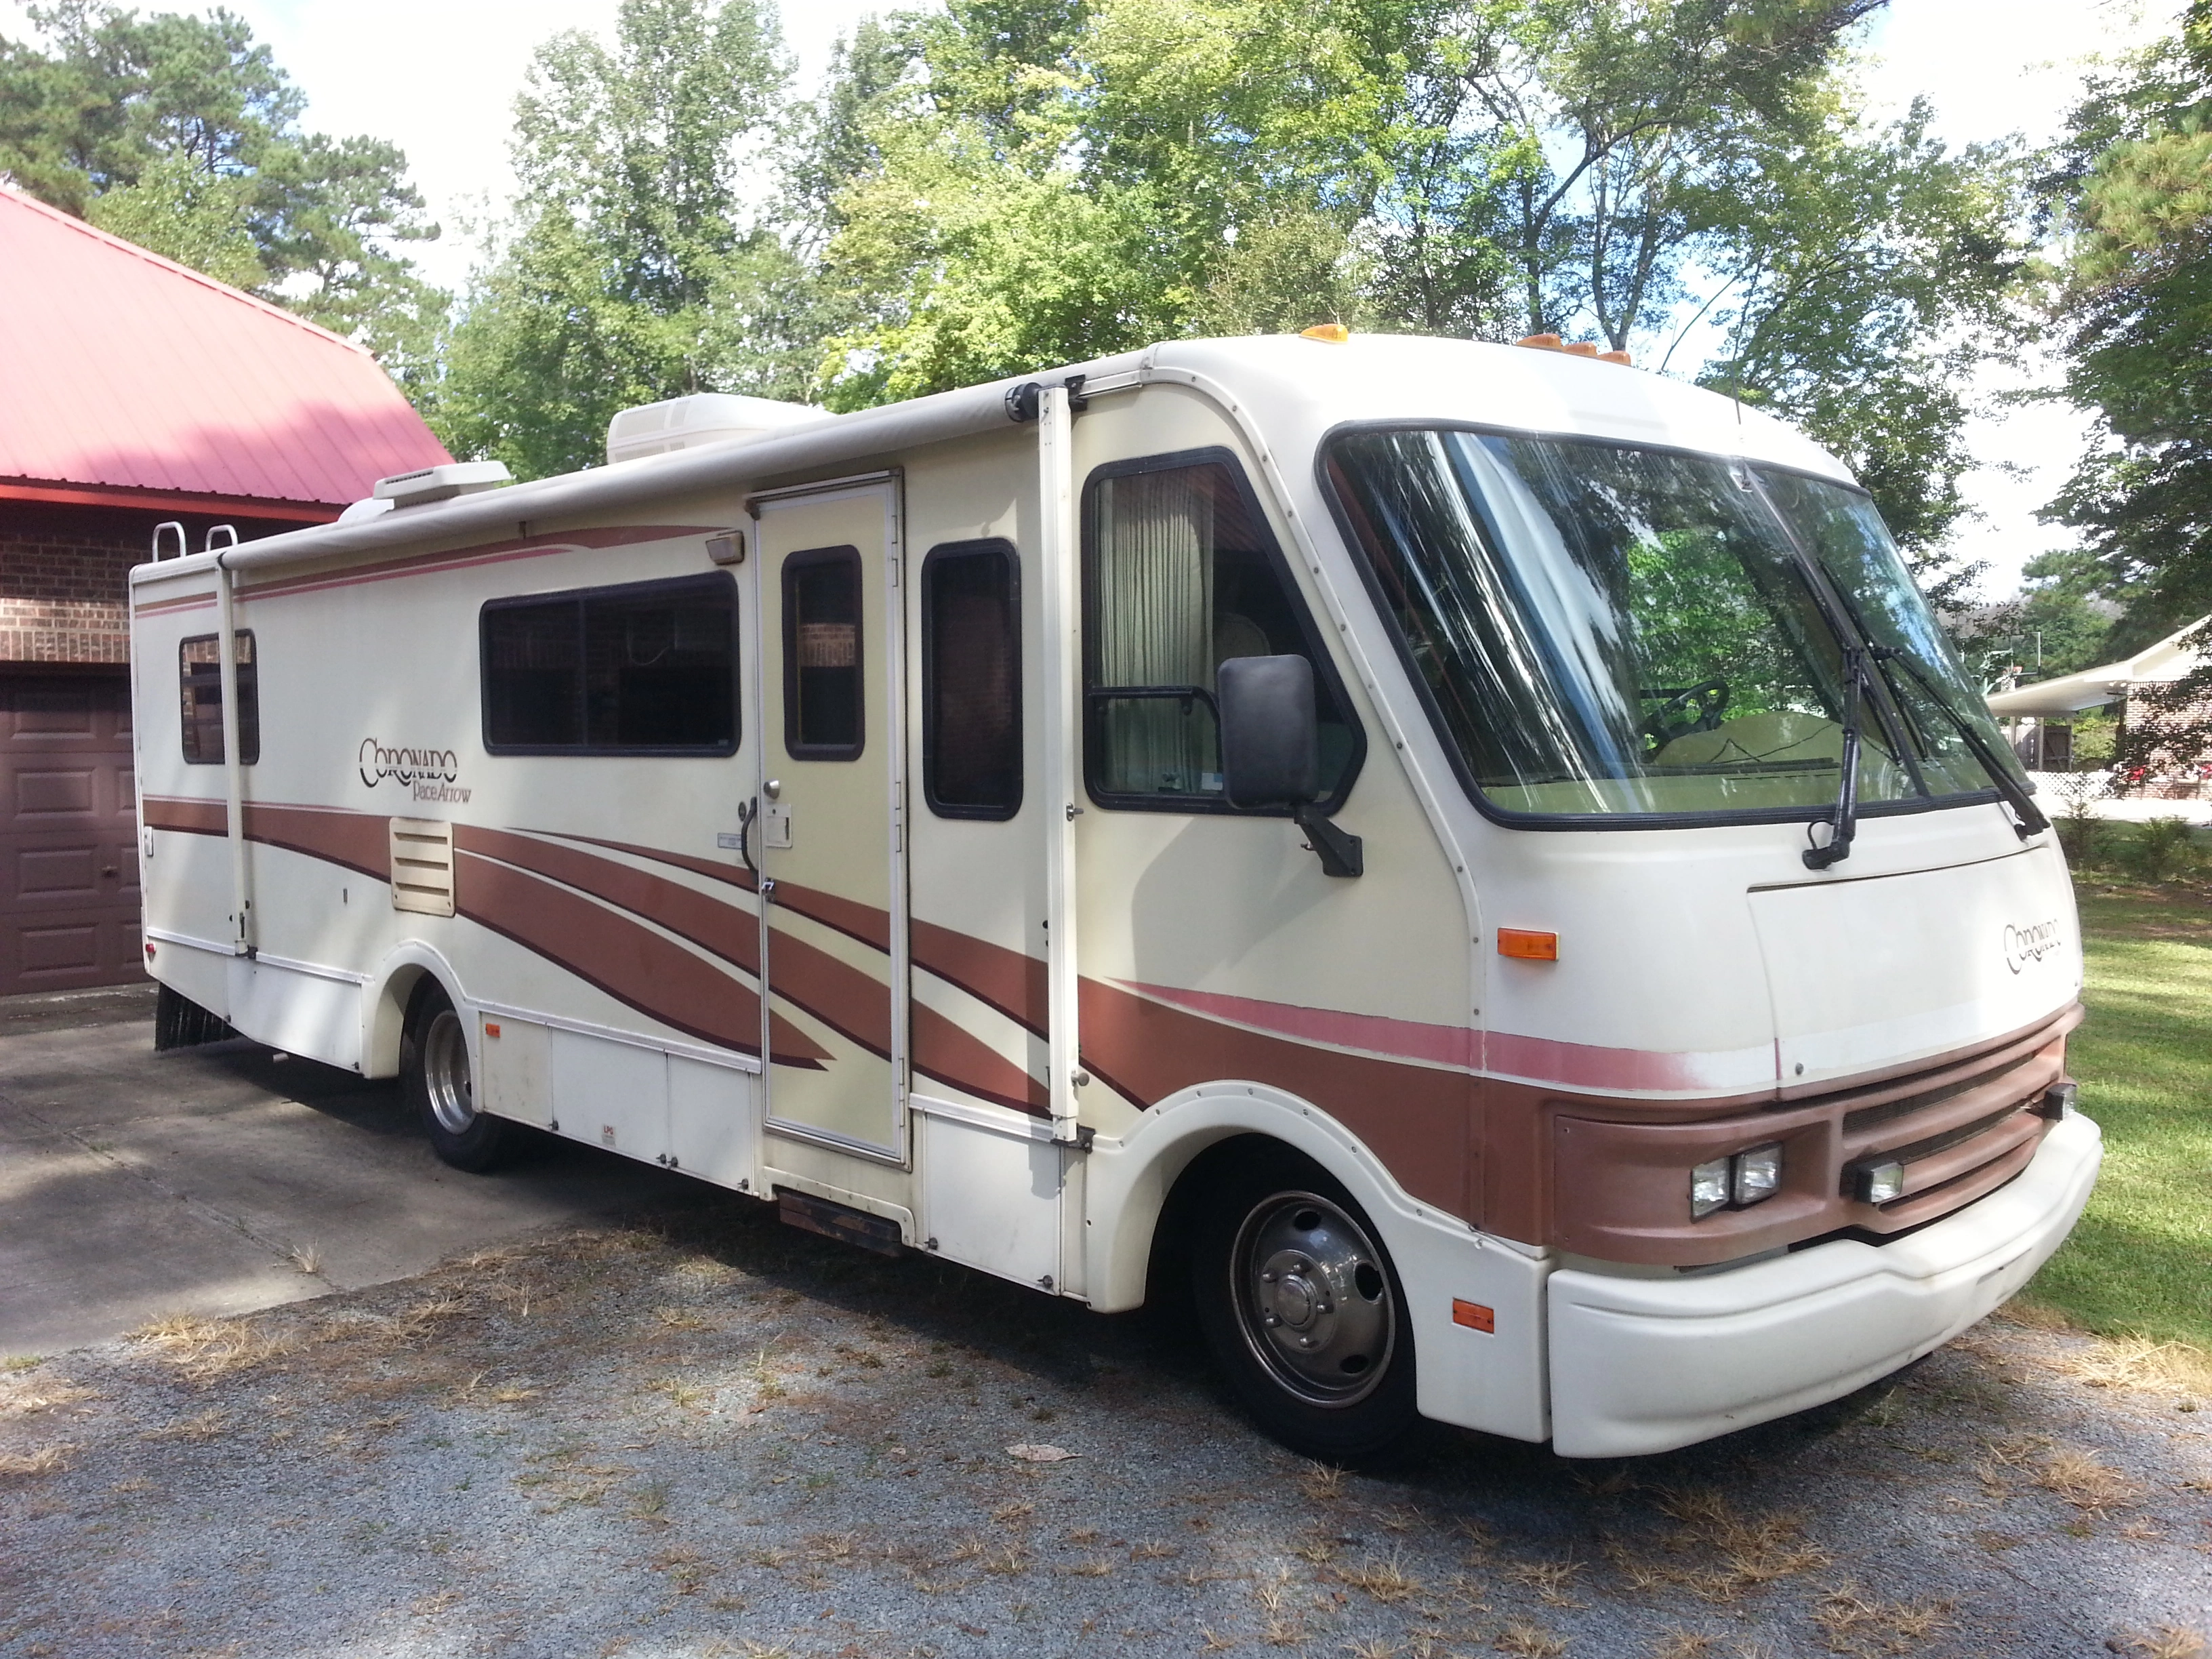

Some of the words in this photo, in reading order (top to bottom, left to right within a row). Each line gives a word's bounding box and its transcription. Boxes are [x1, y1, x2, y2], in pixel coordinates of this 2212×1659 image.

[360, 738, 457, 788] CORONADO
[413, 781, 437, 801] Pace
[438, 783, 472, 803] Arrow
